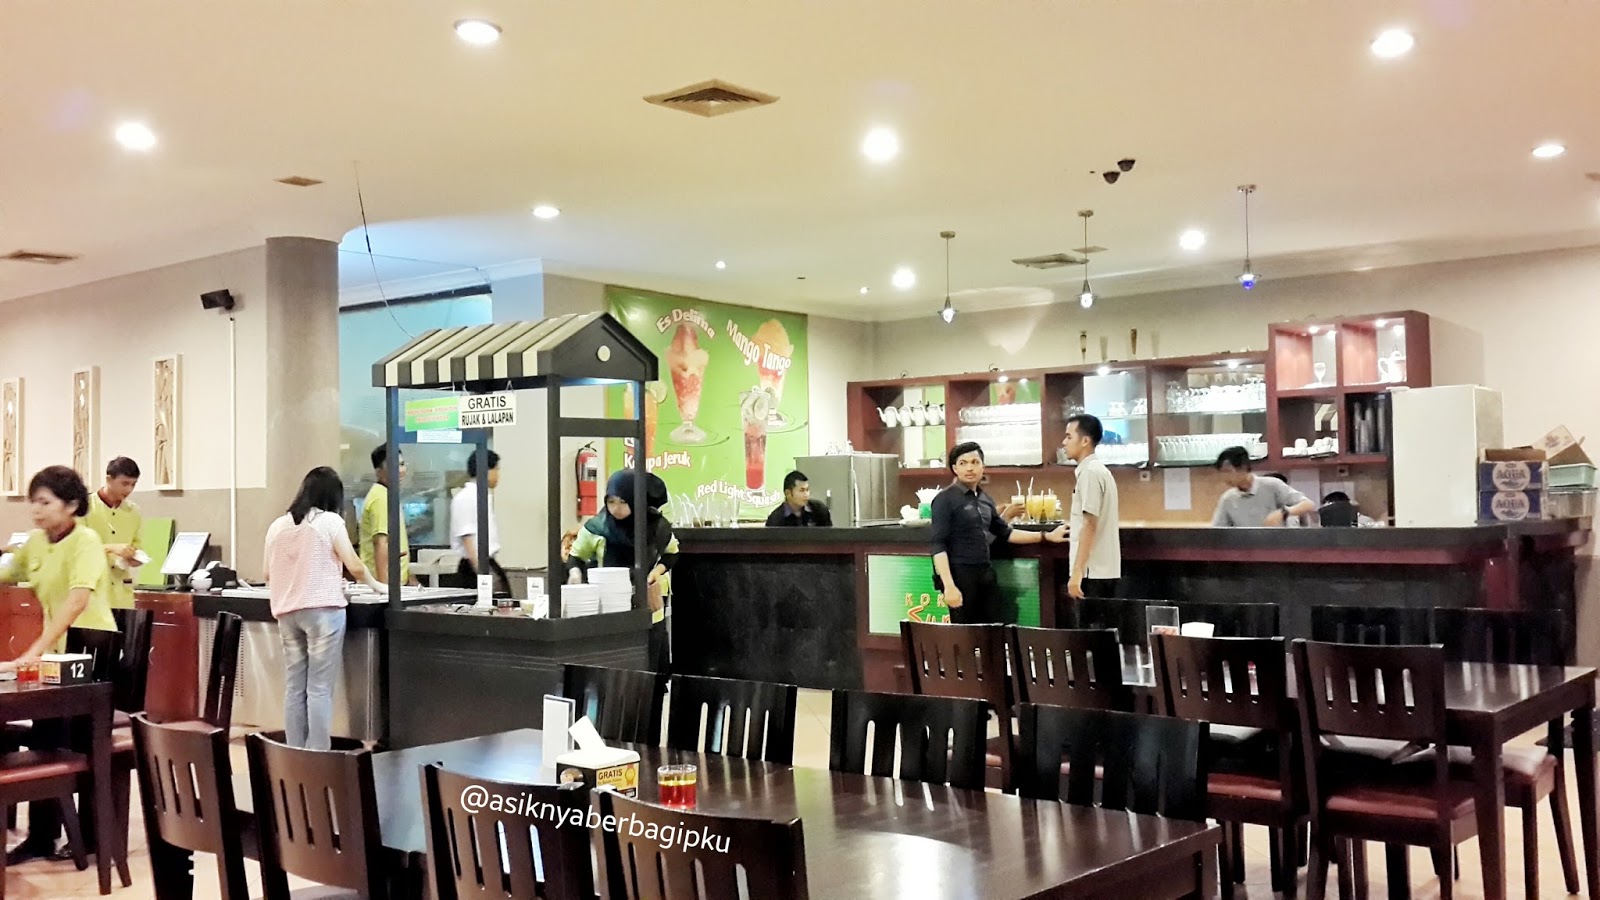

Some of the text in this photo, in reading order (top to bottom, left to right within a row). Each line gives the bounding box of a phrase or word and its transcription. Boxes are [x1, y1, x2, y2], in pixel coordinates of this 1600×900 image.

[656, 308, 716, 339] Es Delima
[726, 319, 792, 376] Mango Tango
[468, 396, 507, 410] GRATIS
[461, 413, 480, 426] RUJAK
[481, 413, 486, 425] &
[487, 411, 514, 425] LALAPAN
[662, 450, 692, 470] Jeruk
[697, 480, 781, 509] Red Light Squash
[70, 662, 85, 678] 12
[598, 768, 623, 780] GRATIS
